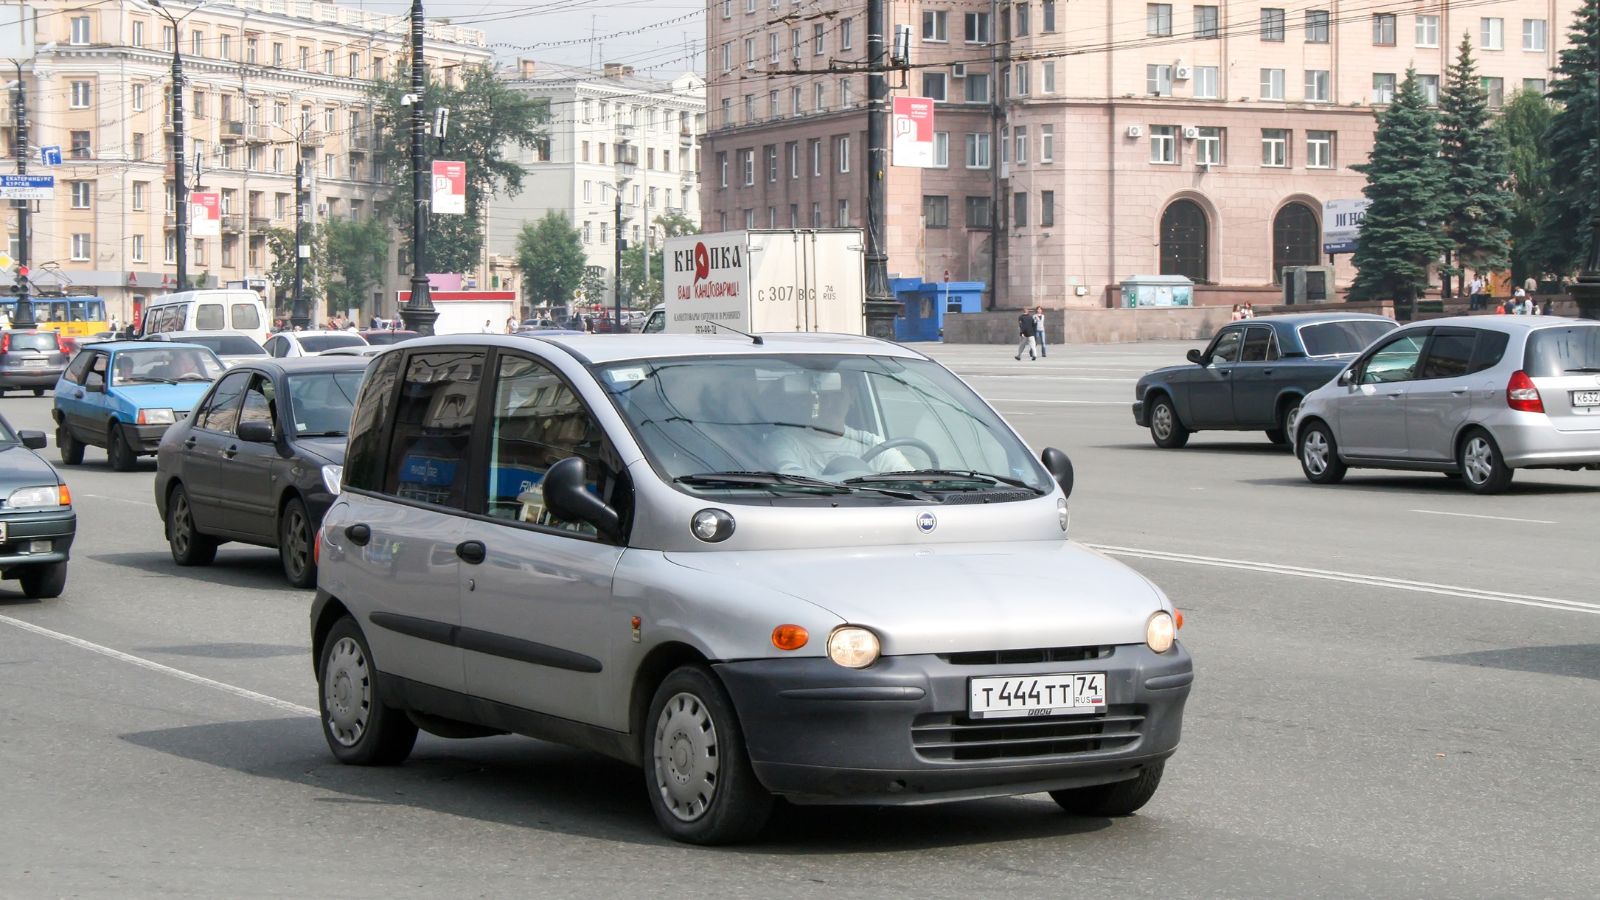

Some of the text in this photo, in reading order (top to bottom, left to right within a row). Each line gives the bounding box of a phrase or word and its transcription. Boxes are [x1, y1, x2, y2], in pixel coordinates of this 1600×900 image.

[674, 243, 742, 280] КНОПКА
[677, 285, 691, 300] ВАШ
[769, 285, 794, 302] 307
[823, 292, 837, 301] RUS
[825, 285, 834, 293] 74
[1076, 676, 1099, 696] 74
[1075, 696, 1091, 704] RUS
